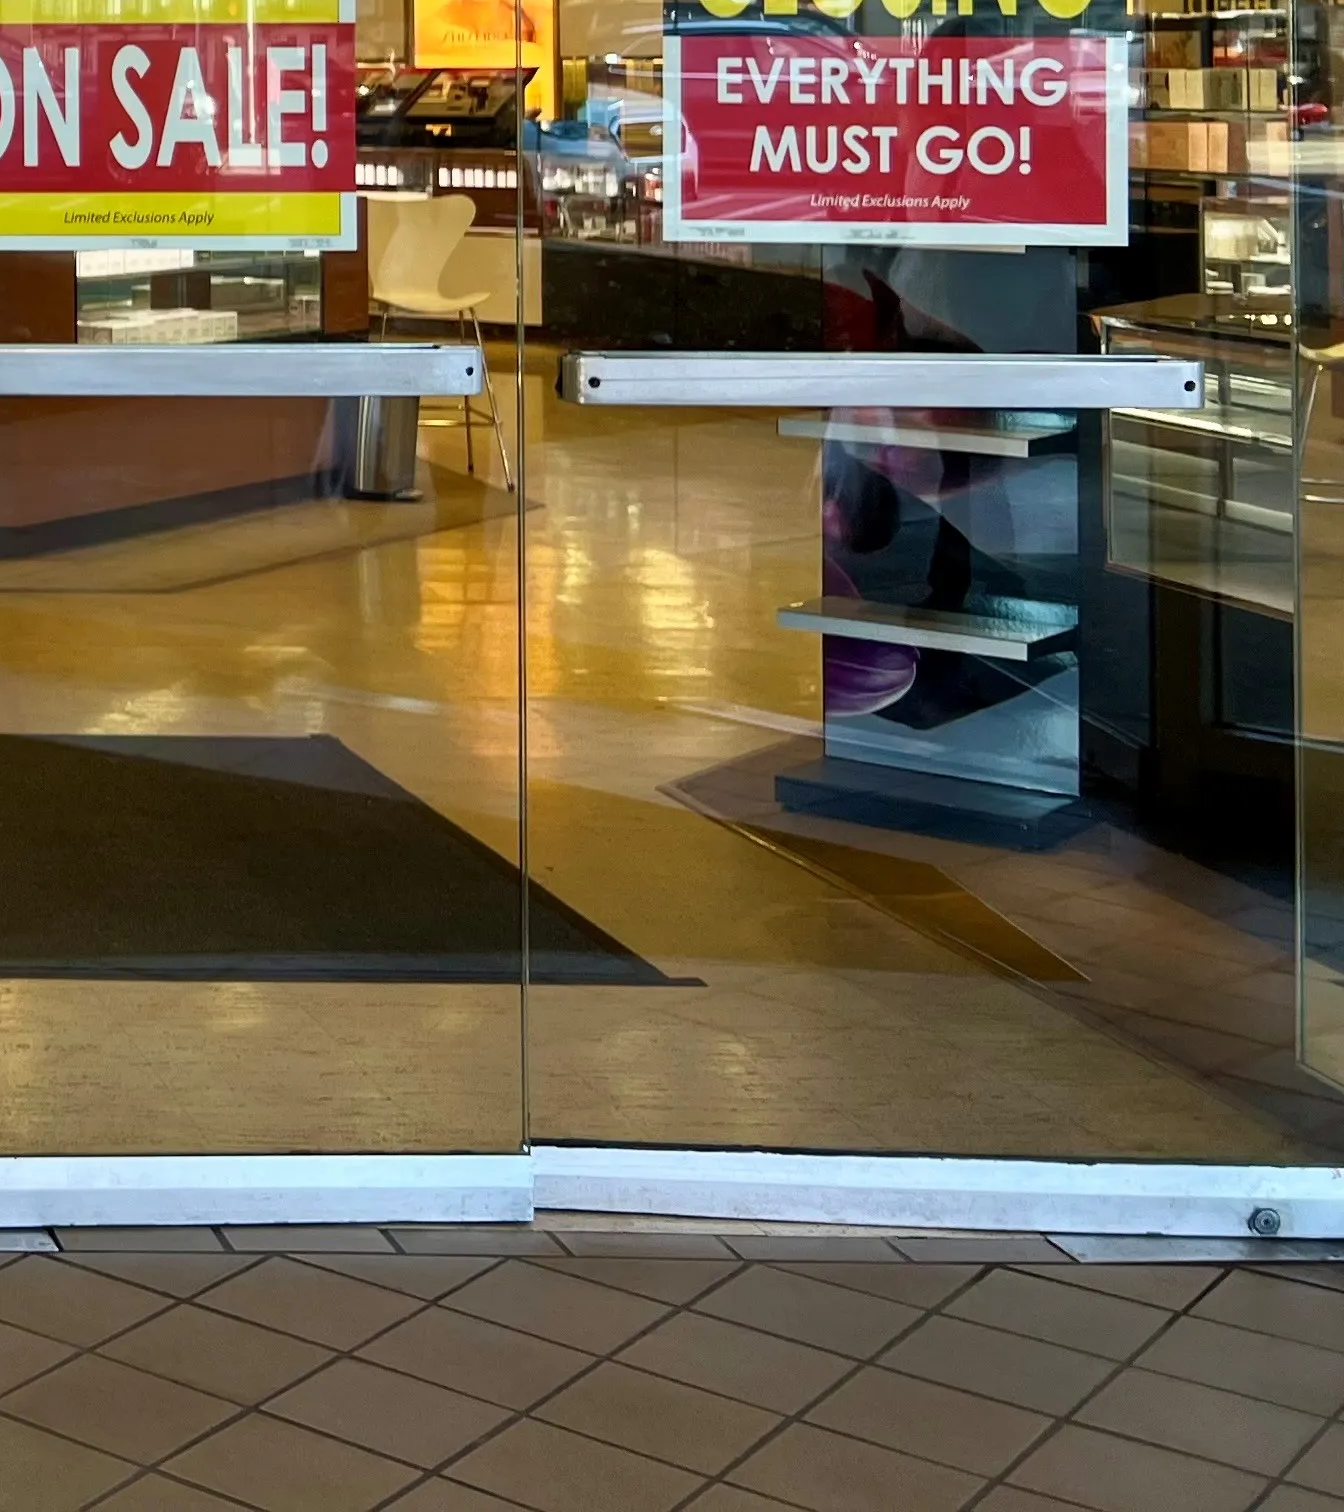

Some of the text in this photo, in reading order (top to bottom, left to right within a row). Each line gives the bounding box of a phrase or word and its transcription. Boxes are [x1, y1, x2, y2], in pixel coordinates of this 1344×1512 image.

[111, 43, 330, 169] SALE!
[716, 58, 1068, 107] EVERYTHING
[749, 125, 1032, 176] MUST GO!
[64, 209, 215, 228] Limited Exclusions Apply
[811, 192, 971, 212] Limited Exclusions Apply
